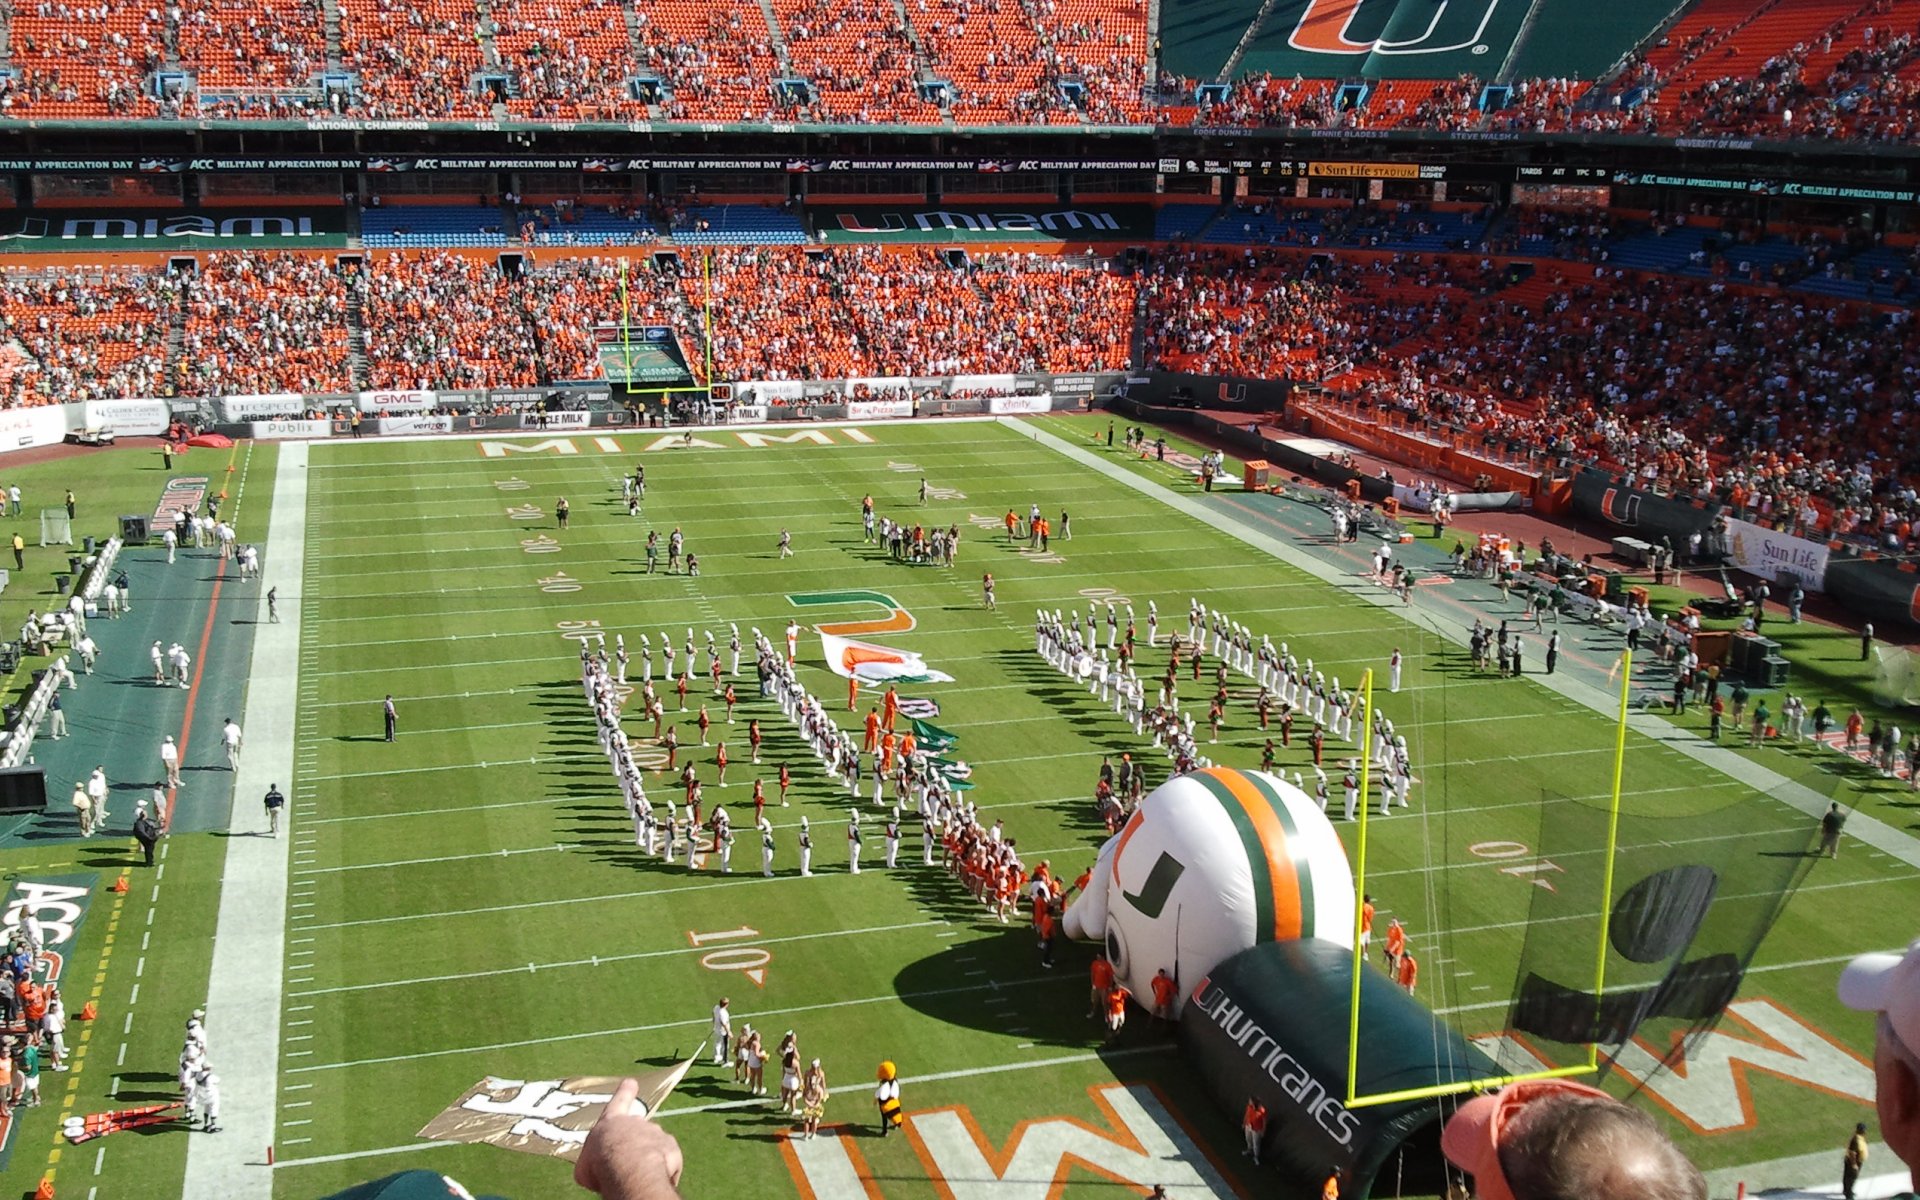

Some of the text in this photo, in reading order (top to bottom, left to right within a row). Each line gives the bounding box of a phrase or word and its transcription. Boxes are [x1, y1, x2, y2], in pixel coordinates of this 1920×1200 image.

[307, 122, 429, 130] NATIONAL CHAMPIONS
[475, 123, 499, 131] 1983
[551, 123, 575, 131] 1987
[701, 124, 723, 132] 1991
[773, 125, 795, 133] 2001
[1451, 132, 1479, 140] STEVE
[1675, 138, 1717, 148] UNIVERSITY
[1718, 139, 1729, 147] OF
[35, 161, 109, 169] APPRECIATION
[112, 161, 133, 169] DAY
[190, 159, 361, 169] ACC MILITARY APPRECIATION DAY
[415, 159, 577, 169] ACC MILITARY APPRECIATION DAY
[627, 160, 781, 169] ACC MILITARY APPRECIATION DAY
[829, 160, 974, 170] ACC MILITARY APPRECIATION DAY
[1018, 160, 1156, 170] ACC MILITARY APPRECIATION DAY
[1325, 165, 1415, 177] Sun Life STADIUM
[1520, 167, 1542, 175] YARDS
[1640, 174, 1656, 184] ACC
[1656, 176, 1685, 186] MILITARY
[1686, 177, 1731, 189] APPRECIATION
[1783, 183, 1914, 201] ACC MILITARY APPRECIATION DAY
[713, 386, 730, 399] 40
[374, 393, 422, 404] GMC
[851, 406, 862, 414] Sir
[872, 406, 893, 414] Pizza
[1003, 400, 1030, 410] xfinity
[739, 408, 760, 419] MILK
[525, 413, 583, 425] MUCLE MILK
[268, 423, 313, 433] Publix
[413, 421, 447, 431] verizon
[478, 428, 877, 458] MIAMI
[1762, 539, 1789, 562] Sun
[1468, 840, 1565, 878] 10
[687, 925, 772, 971] 10
